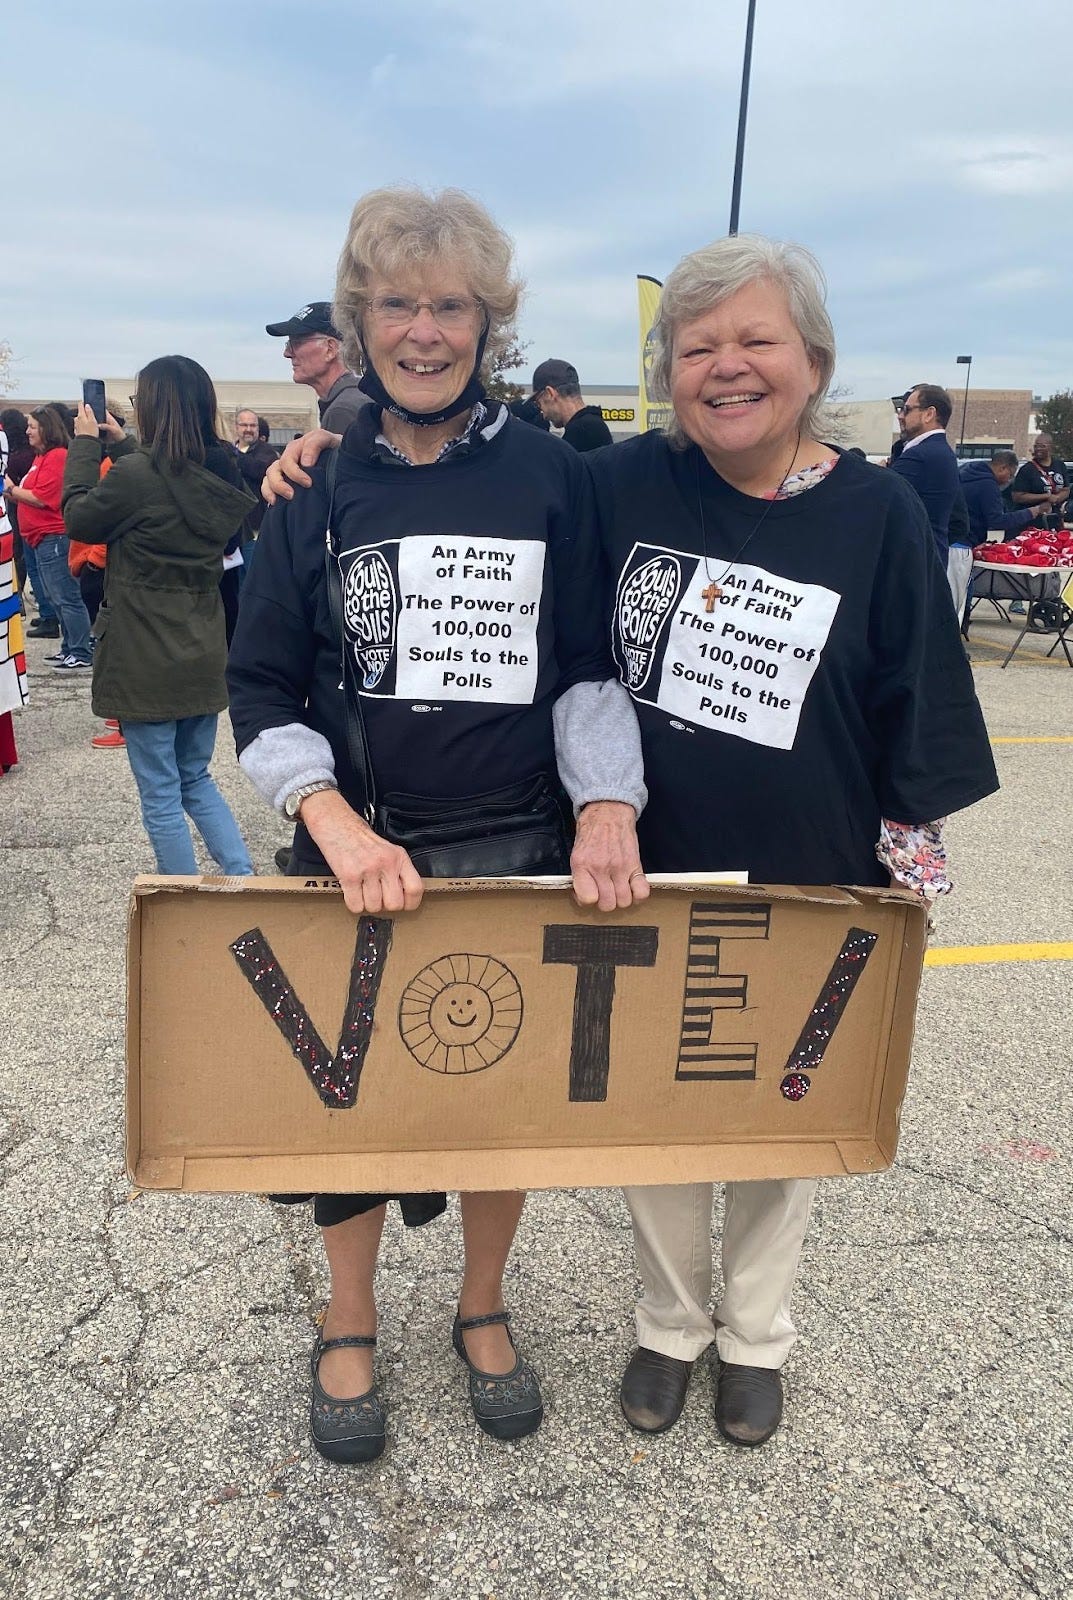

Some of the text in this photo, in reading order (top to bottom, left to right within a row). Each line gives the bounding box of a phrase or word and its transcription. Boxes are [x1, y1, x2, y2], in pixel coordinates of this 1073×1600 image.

[431, 545, 515, 566] An Army
[346, 558, 389, 597] Souls
[436, 564, 512, 581] of Faith
[631, 560, 676, 598] Souls
[346, 589, 391, 617] to the
[405, 594, 536, 615] The Power of
[624, 586, 669, 614] to the
[722, 574, 804, 608] An Army
[719, 594, 793, 621] of Faith
[432, 620, 512, 639] 100,000
[679, 610, 816, 663] The Power of
[360, 649, 390, 661] VOTE
[409, 646, 529, 666] Souls to the
[625, 646, 648, 665] VOTE
[698, 643, 779, 679] 100,000
[443, 671, 492, 688] Polls
[672, 662, 791, 710] Souls to the
[699, 696, 748, 723] Polls
